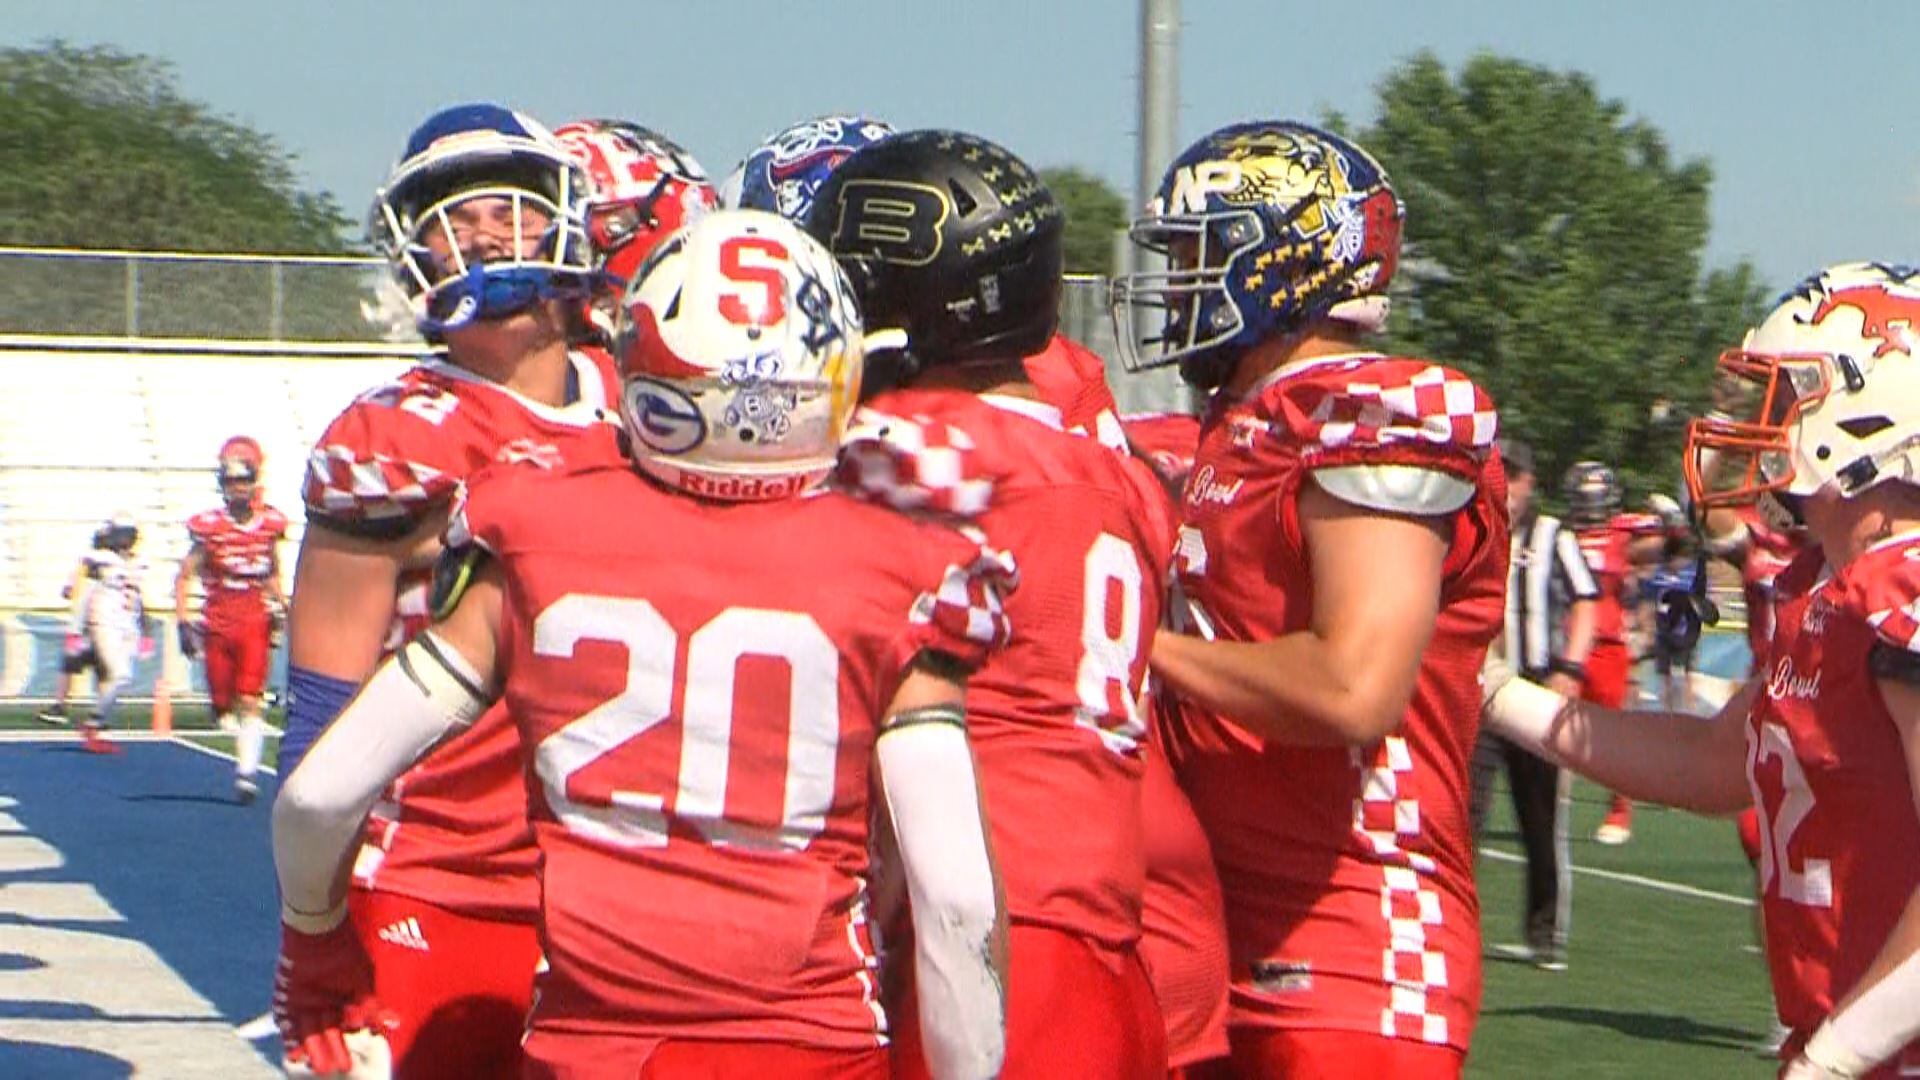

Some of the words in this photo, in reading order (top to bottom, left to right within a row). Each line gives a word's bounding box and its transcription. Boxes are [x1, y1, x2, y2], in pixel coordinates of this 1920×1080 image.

[830, 178, 951, 267] B
[1168, 159, 1242, 216] NP
[717, 236, 788, 328] S
[679, 469, 808, 498] Riddell
[1187, 464, 1244, 505] Bowl
[1075, 530, 1147, 760] 8
[1767, 654, 1822, 700] Bowl
[533, 591, 839, 851] 20
